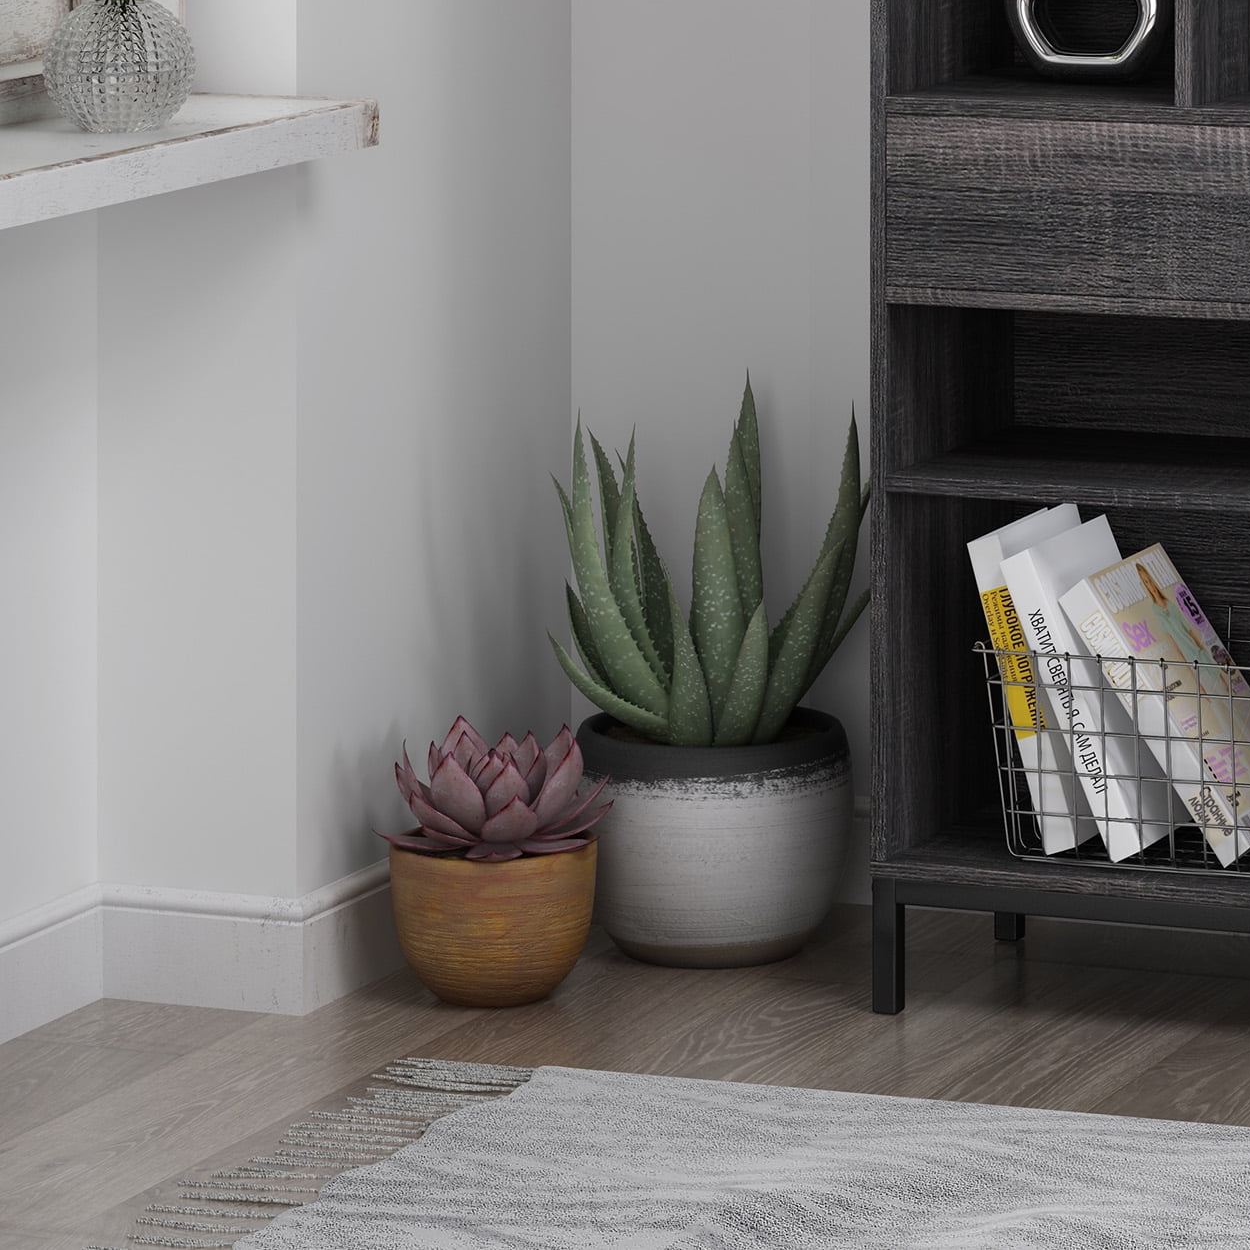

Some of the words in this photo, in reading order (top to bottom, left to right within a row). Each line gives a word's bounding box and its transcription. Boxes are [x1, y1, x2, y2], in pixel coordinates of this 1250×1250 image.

[1094, 549, 1178, 614] COSMOPITAN
[982, 592, 996, 627] Overlay
[998, 587, 1025, 650] ГЛУБОКОЕ
[1183, 595, 1200, 617] 15
[1028, 608, 1057, 656] ХВАТИТ
[1121, 618, 1158, 652] Sex
[1066, 708, 1080, 720] Я
[1072, 722, 1092, 752] САМ
[1079, 751, 1108, 795] ДЕЛАЛ
